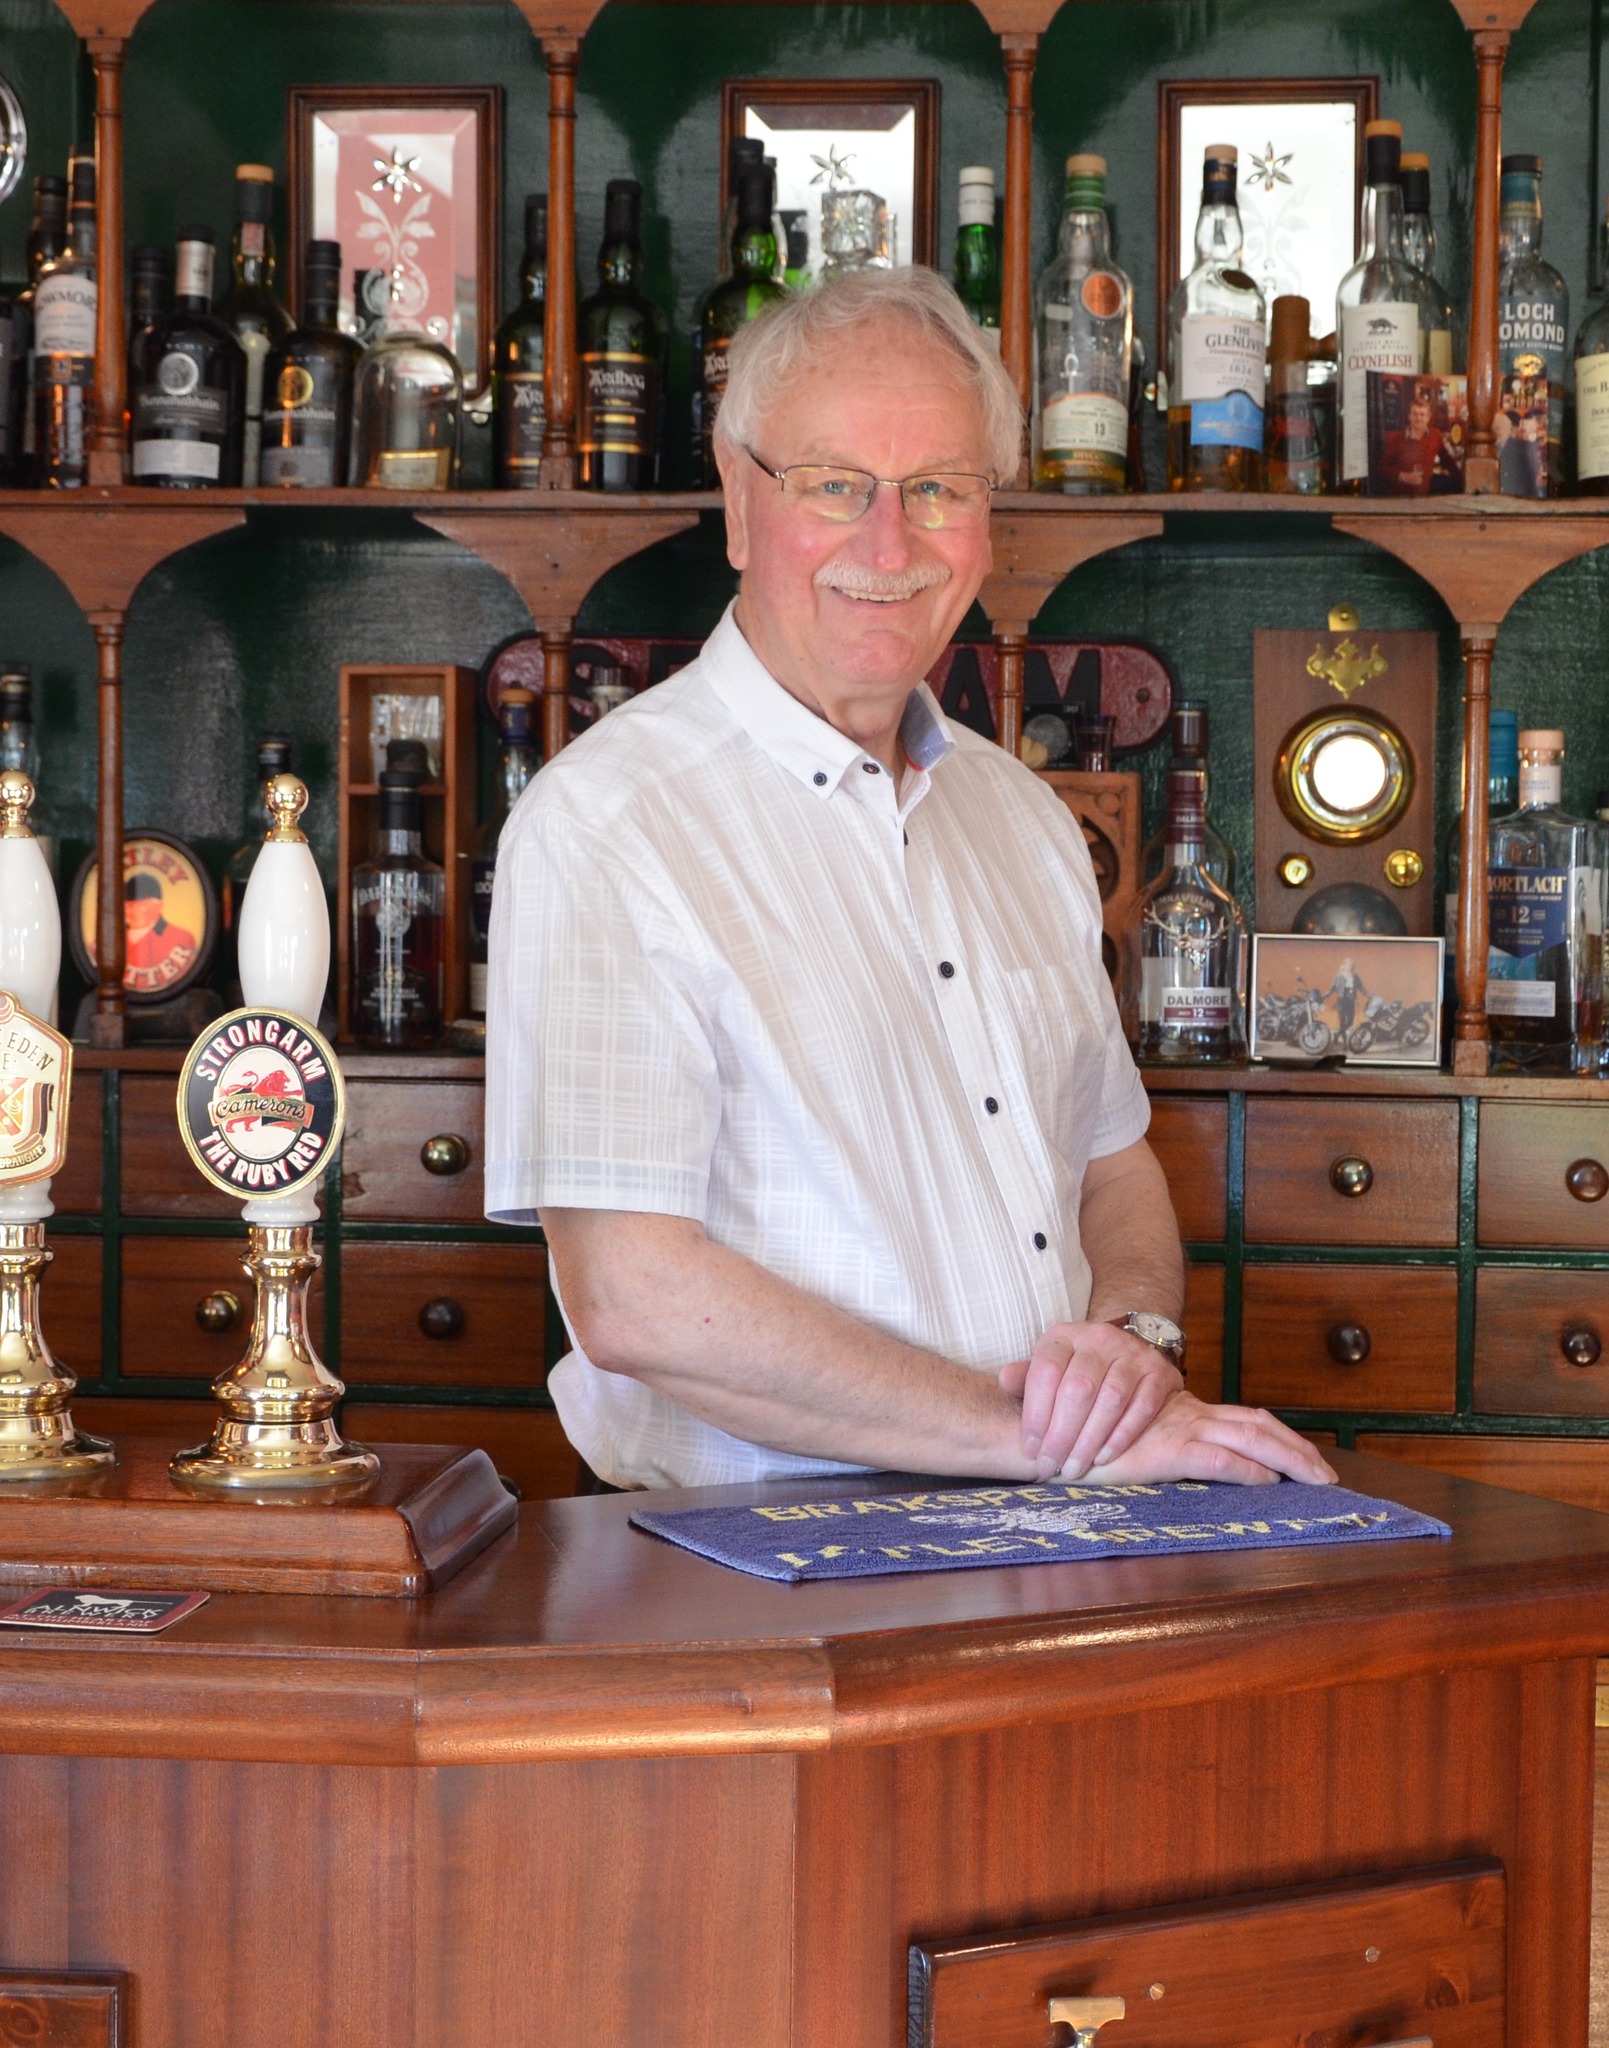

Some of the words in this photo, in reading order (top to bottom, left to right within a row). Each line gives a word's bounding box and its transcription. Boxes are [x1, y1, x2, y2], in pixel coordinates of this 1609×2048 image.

[1504, 302, 1555, 322] LOCH
[1233, 325, 1250, 335] THE
[1499, 322, 1565, 344] OMOND
[1348, 353, 1413, 371] CLYNELISH
[1511, 905, 1530, 924] 12
[1167, 995, 1228, 1006] DALMORE
[1192, 1008, 1204, 1018] 12
[6, 1031, 55, 1071] EDEN
[195, 1019, 327, 1083] STRONGARM
[215, 1097, 307, 1120] Camerons
[199, 1130, 238, 1175] THE
[231, 1160, 292, 1187] RUBY
[286, 1131, 324, 1173] RED
[30, 1604, 164, 1616] ALNWICK
